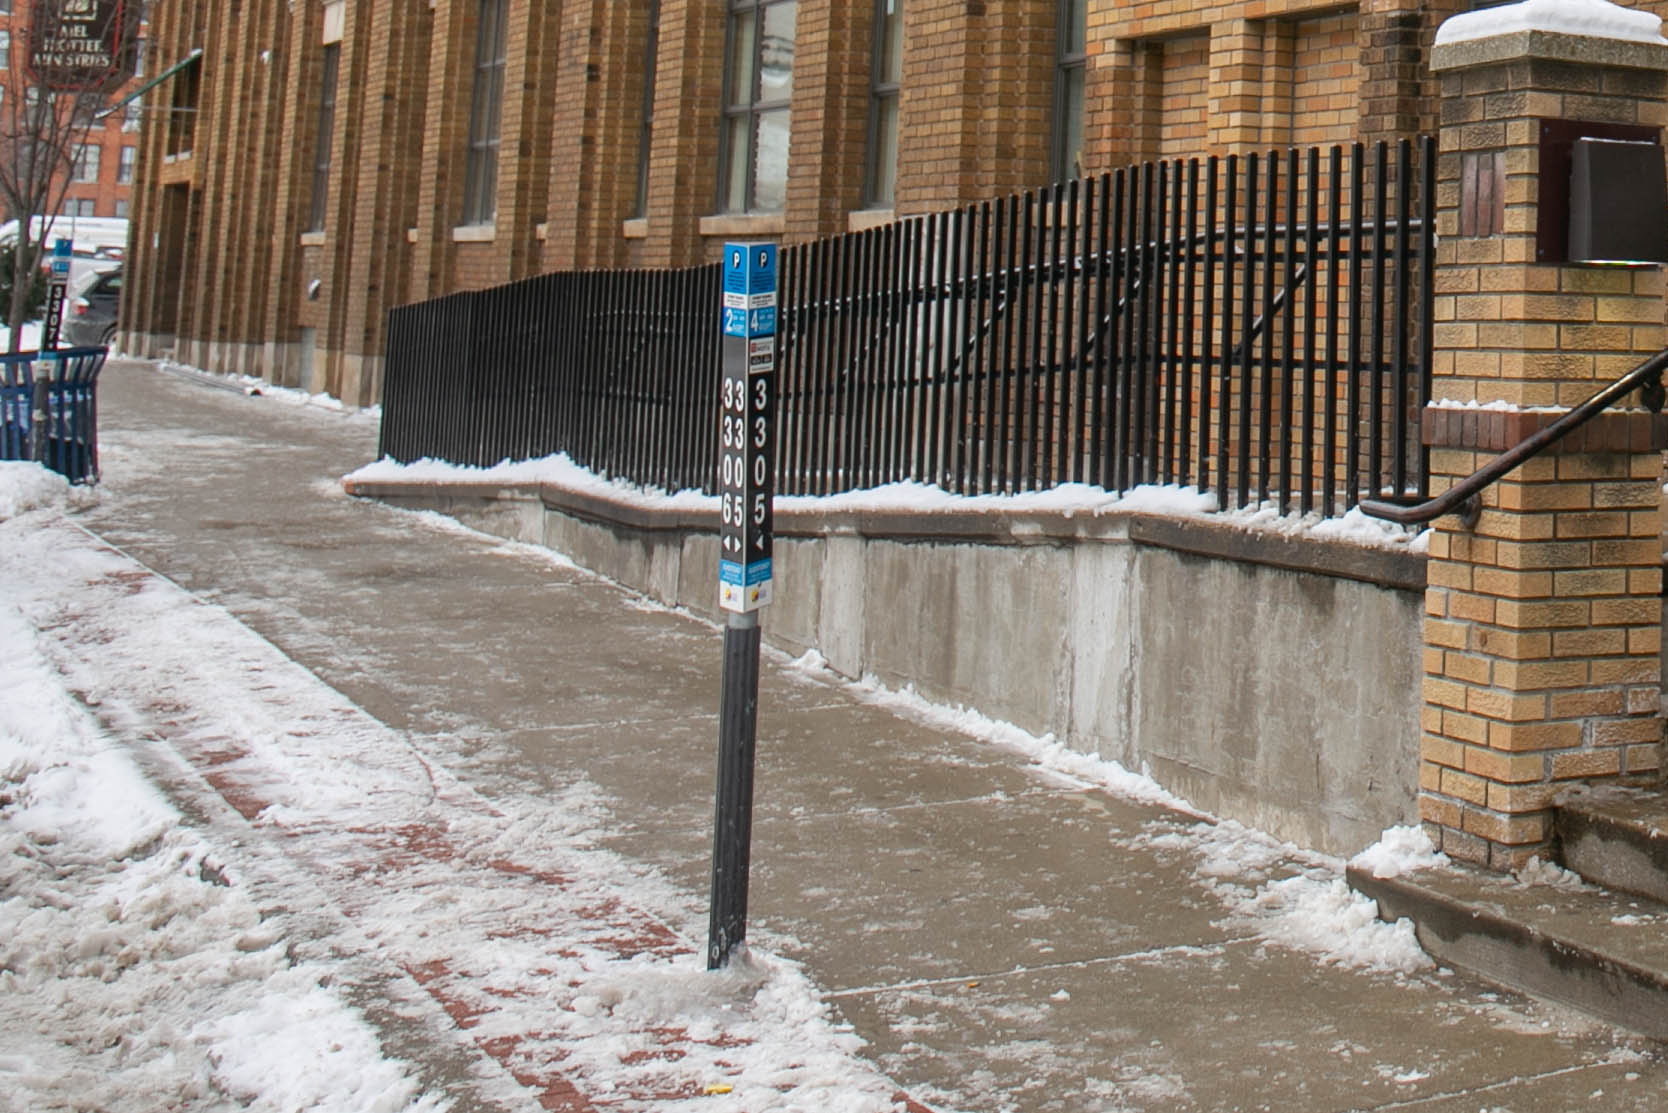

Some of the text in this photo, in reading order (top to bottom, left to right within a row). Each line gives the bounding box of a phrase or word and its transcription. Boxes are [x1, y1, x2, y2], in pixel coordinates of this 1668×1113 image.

[726, 308, 733, 332] 2
[750, 309, 759, 332] 4
[754, 378, 767, 525] 3305
